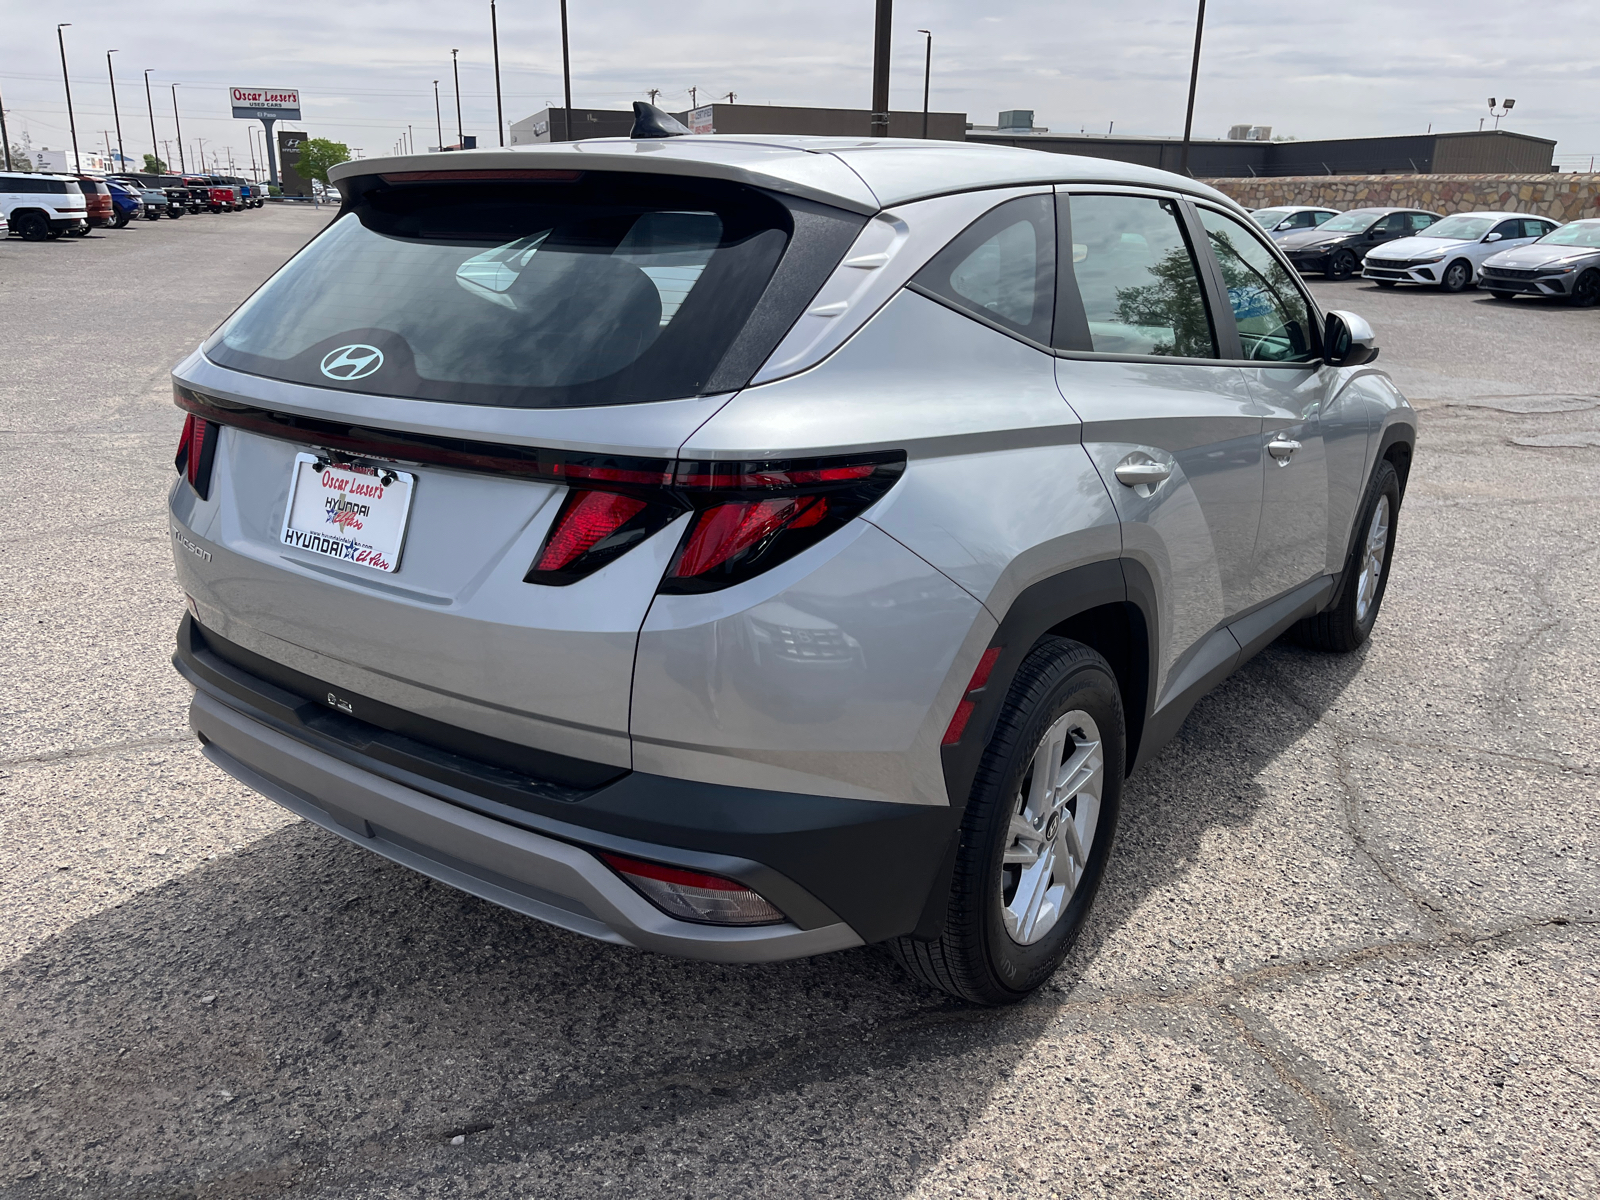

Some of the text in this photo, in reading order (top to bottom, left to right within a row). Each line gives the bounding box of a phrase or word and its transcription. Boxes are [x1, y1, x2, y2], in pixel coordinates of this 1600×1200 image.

[233, 88, 297, 103] Oscar Leeser's
[321, 470, 384, 500] Oscar Leeser's
[325, 497, 370, 517] HYUNDAI
[333, 511, 363, 530] El Paso
[284, 529, 344, 557] HYUNDAI
[355, 550, 390, 570] El Paso
